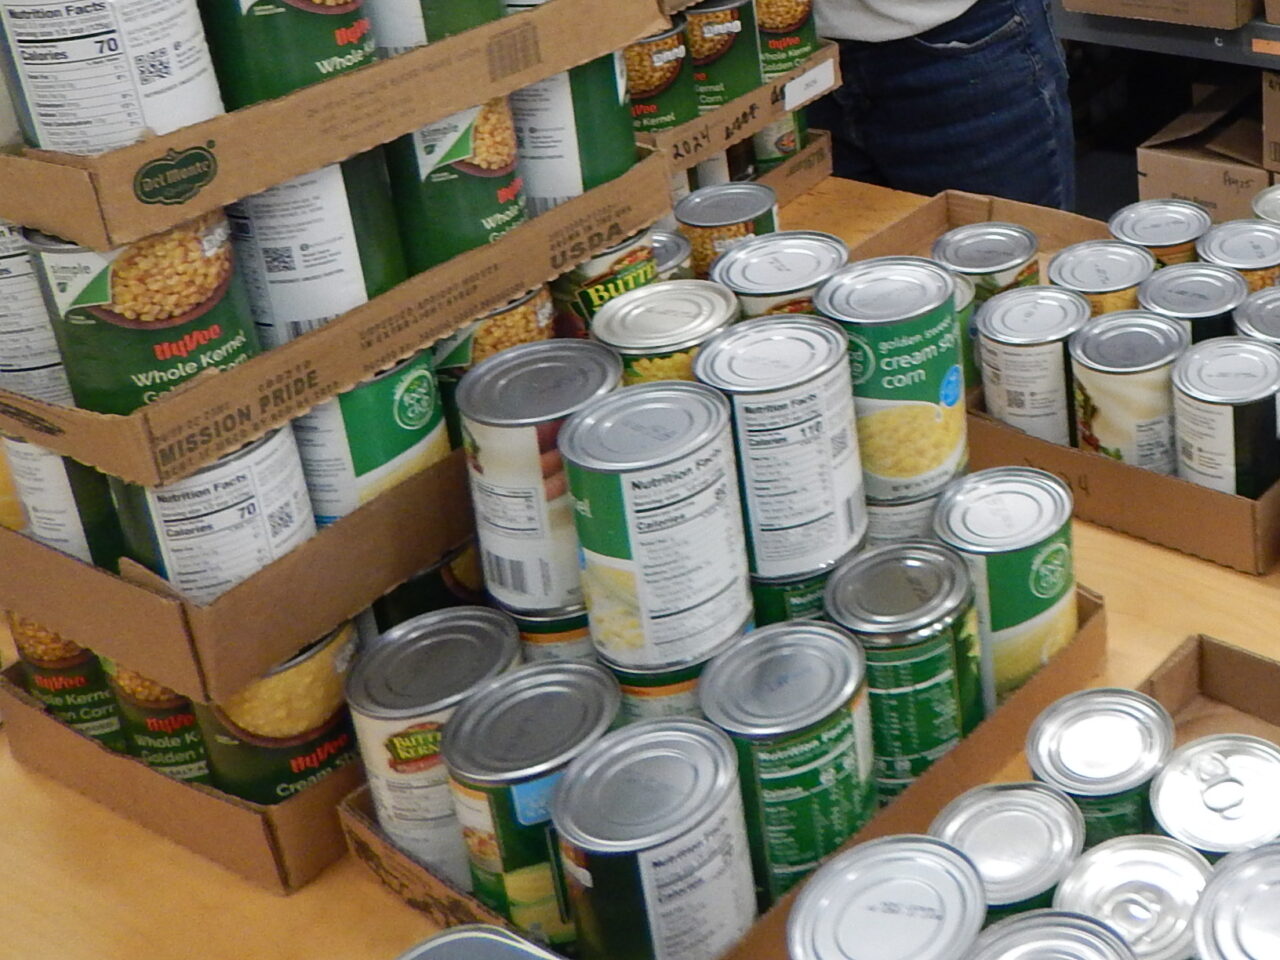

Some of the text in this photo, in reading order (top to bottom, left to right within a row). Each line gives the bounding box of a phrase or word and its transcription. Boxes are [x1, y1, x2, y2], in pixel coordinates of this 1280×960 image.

[8, 1, 107, 20] Nutrition Facts
[20, 37, 119, 61] Calories 70
[699, 93, 723, 103] Corn
[642, 112, 676, 125] Kernel
[672, 124, 710, 160] 2024
[551, 222, 623, 270] USDA
[588, 261, 657, 308] BUTTE
[877, 331, 922, 355] golden
[879, 343, 940, 372] cream
[130, 361, 199, 388] Whole
[881, 368, 927, 390] corn
[157, 404, 251, 468] MISSION
[258, 369, 320, 414] PRIDE
[630, 466, 693, 492] Nutrition
[156, 486, 211, 504] Nutrition
[237, 503, 256, 520] 70
